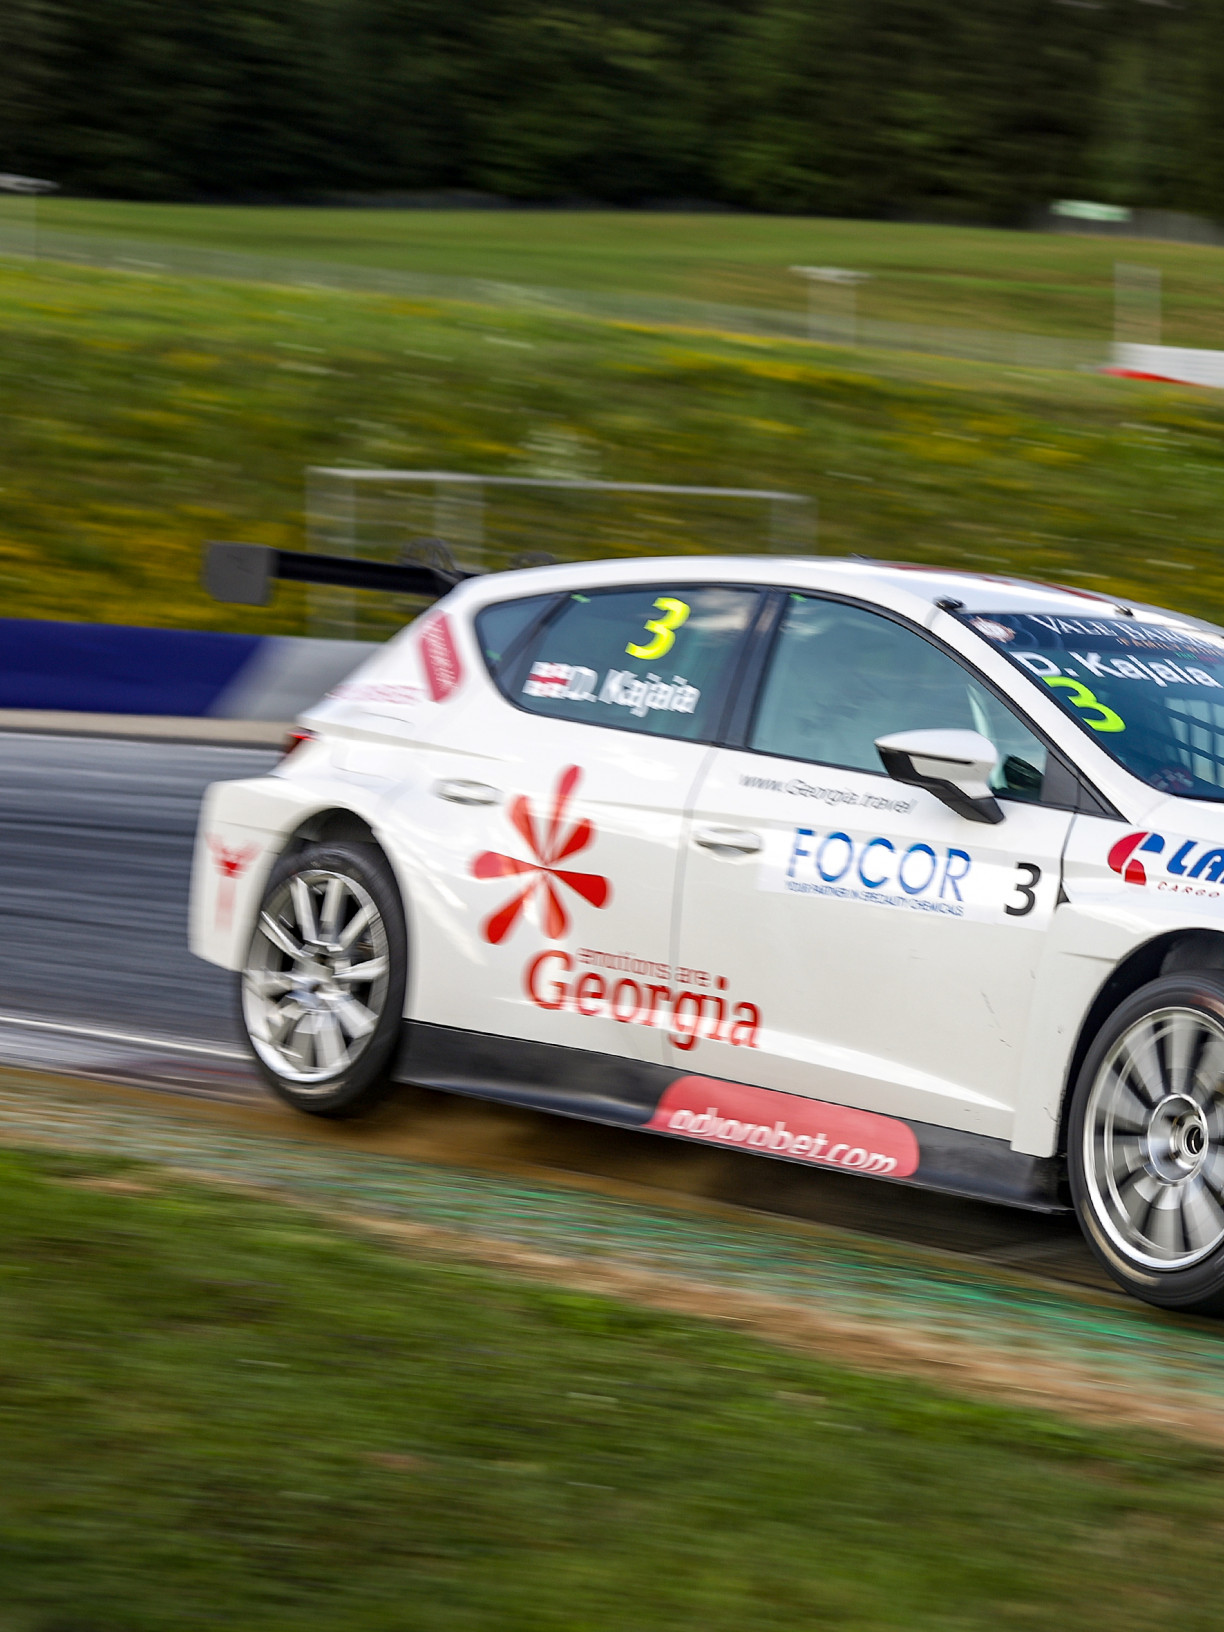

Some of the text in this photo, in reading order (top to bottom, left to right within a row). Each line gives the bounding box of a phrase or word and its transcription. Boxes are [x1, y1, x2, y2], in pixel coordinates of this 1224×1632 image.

[625, 597, 691, 660] 3
[1009, 651, 1080, 678] D.
[1041, 676, 1127, 733] 3
[786, 827, 972, 902] FOCOR
[1004, 862, 1041, 917] 3
[1157, 881, 1220, 899] CARGO
[521, 949, 763, 1051] Georgia
[675, 966, 711, 987] are
